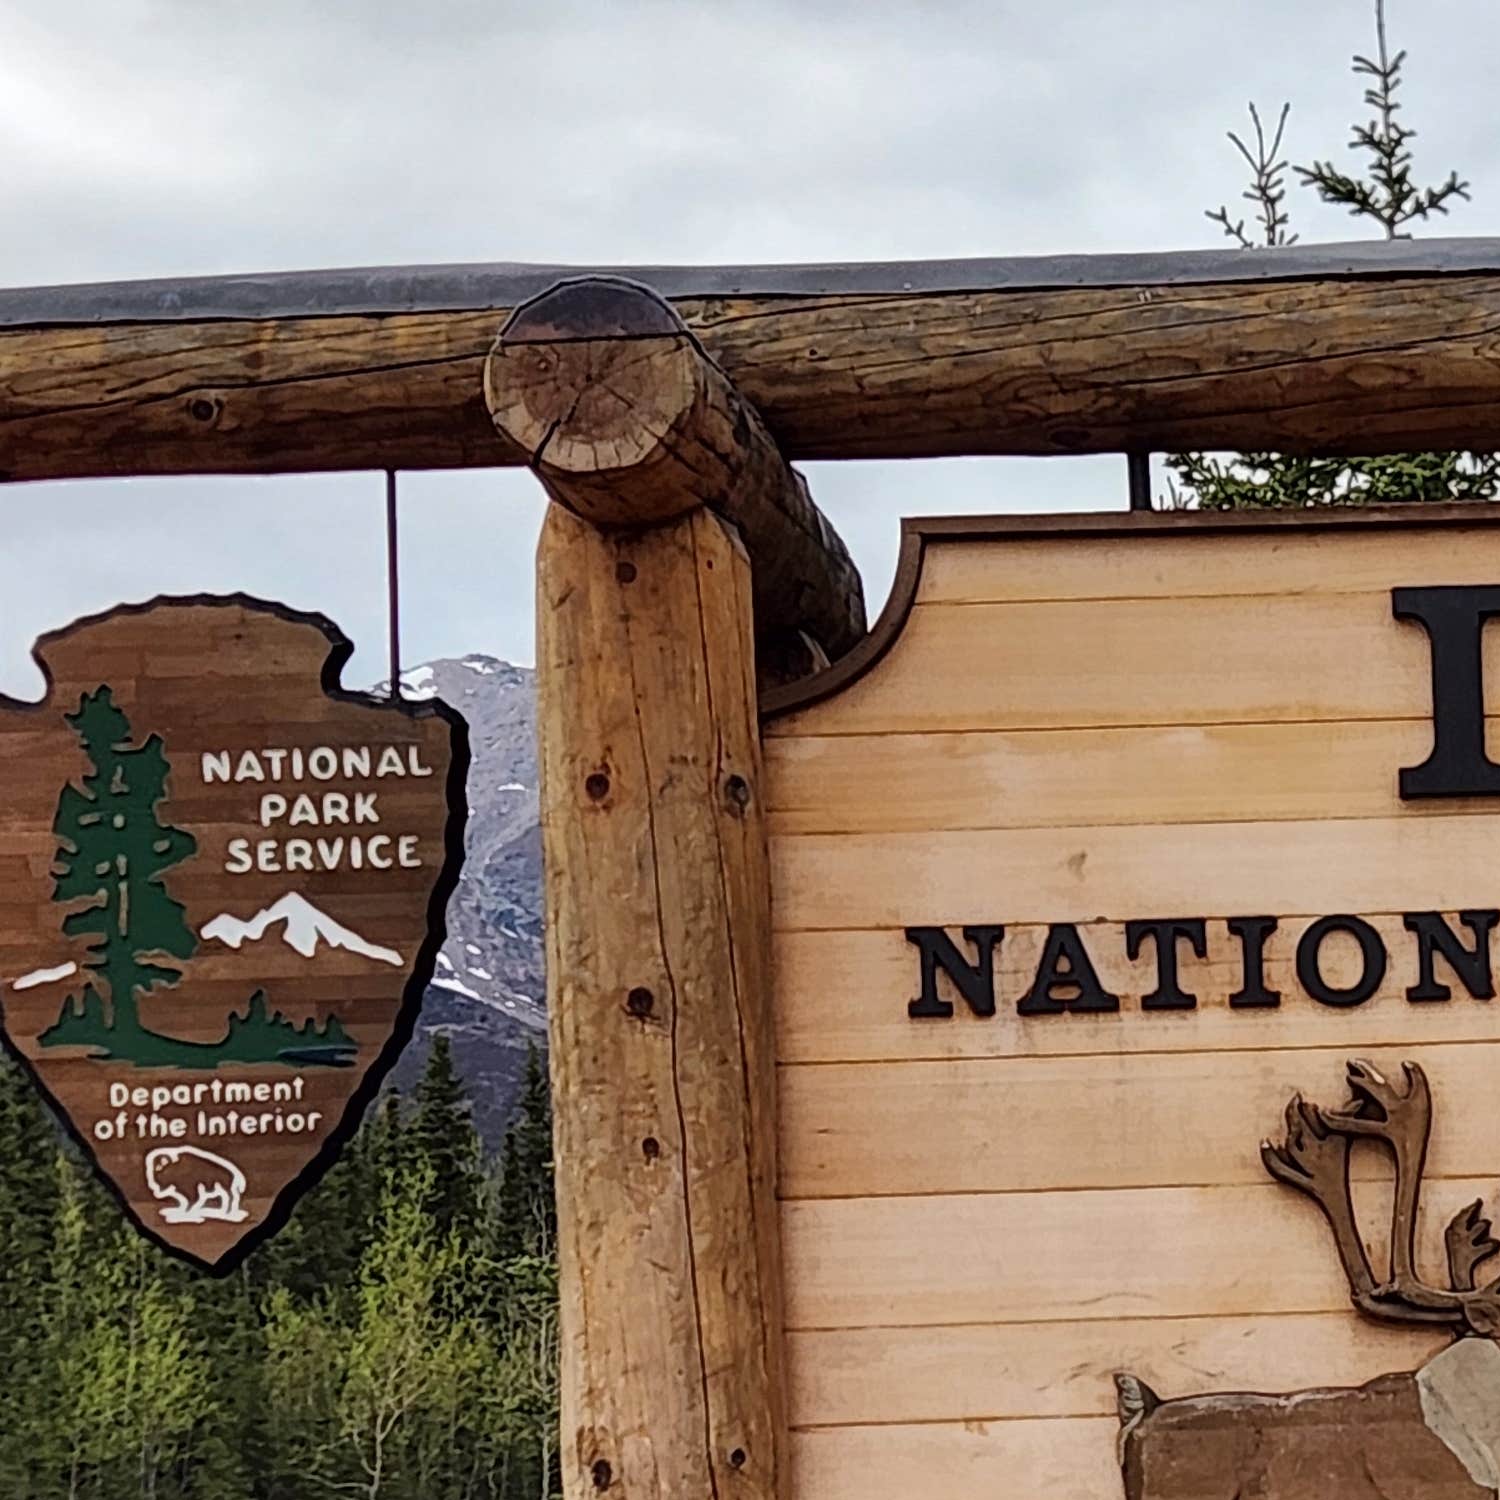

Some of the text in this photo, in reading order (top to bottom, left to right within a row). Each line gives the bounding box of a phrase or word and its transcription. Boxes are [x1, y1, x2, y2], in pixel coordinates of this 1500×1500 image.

[203, 747, 432, 782] NATIONAL
[261, 793, 379, 827] PARK
[225, 836, 421, 873] SERVICE
[110, 1077, 304, 1111] Department
[94, 1107, 323, 1140] of the Interior
